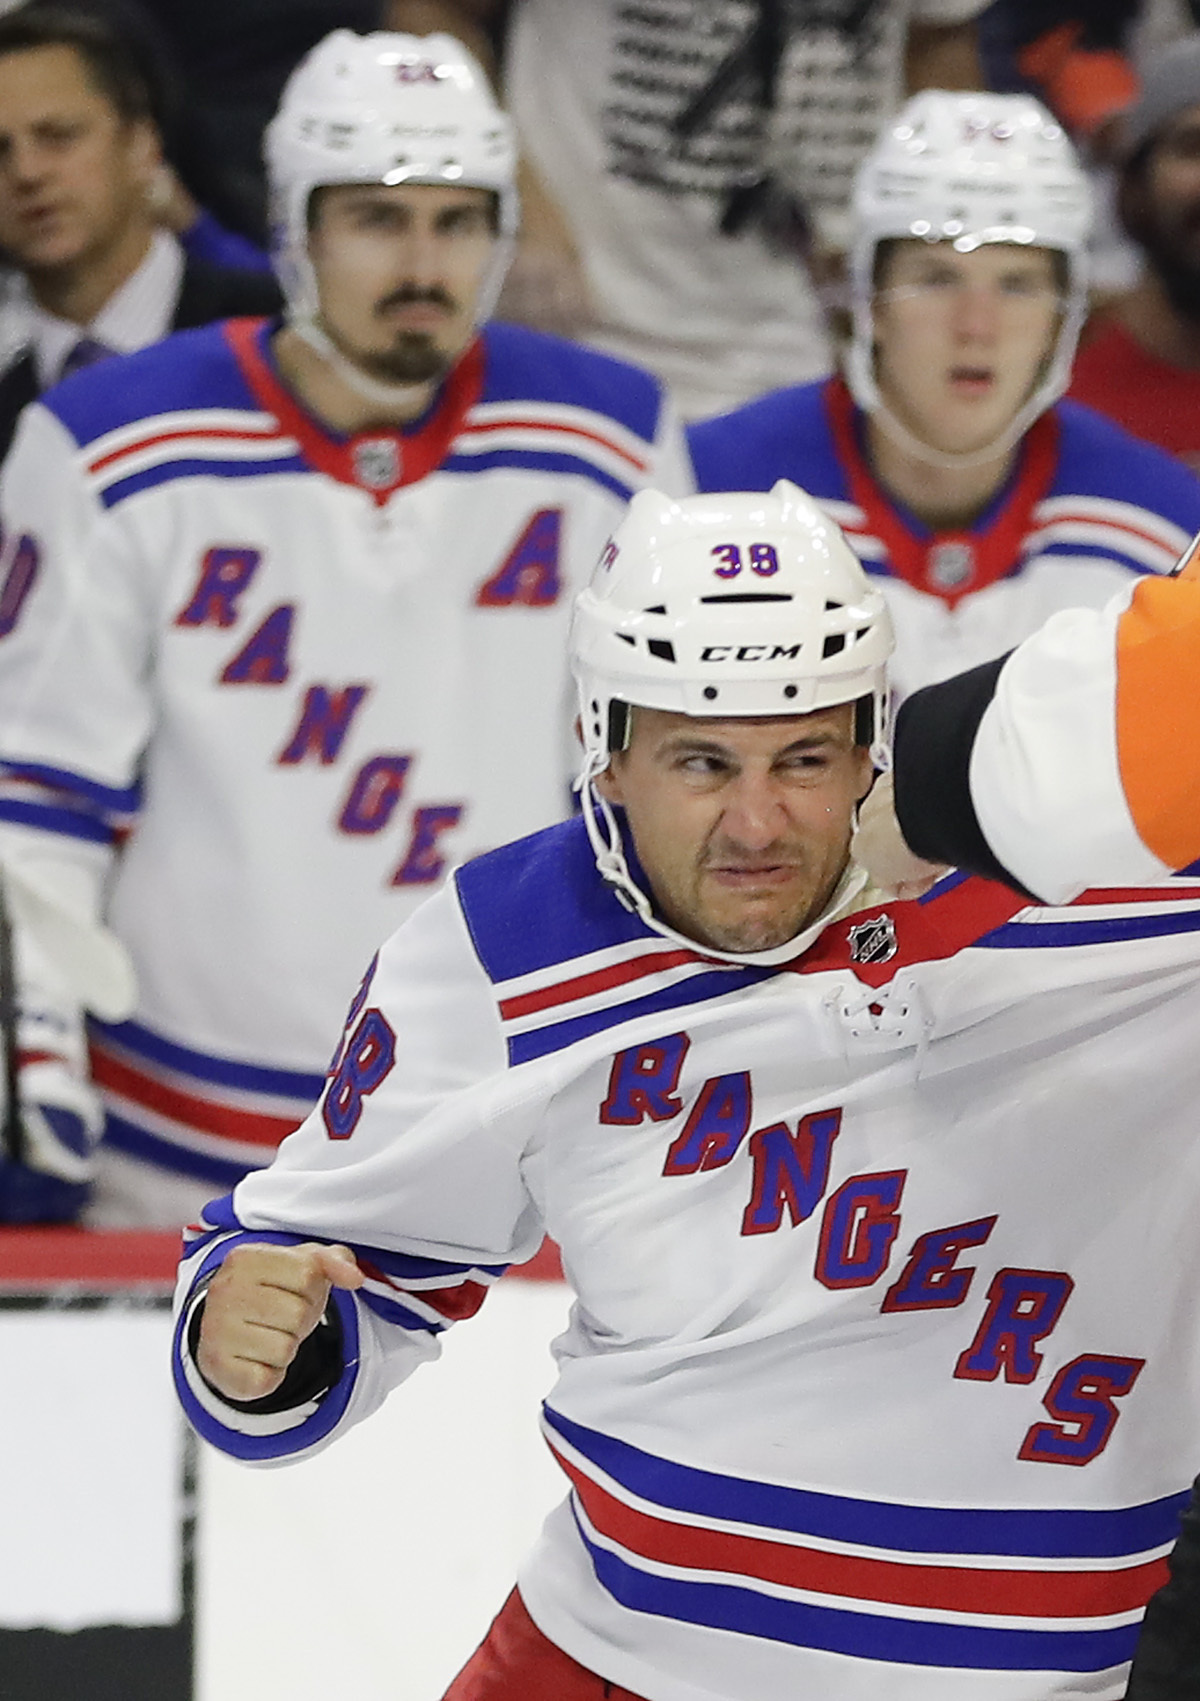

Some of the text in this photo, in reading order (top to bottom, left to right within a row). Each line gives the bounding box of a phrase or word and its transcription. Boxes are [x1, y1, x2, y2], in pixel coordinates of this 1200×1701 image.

[476, 507, 563, 607] A
[711, 543, 779, 579] 38
[700, 644, 802, 662] CCM
[173, 547, 468, 888] RANGE
[599, 1031, 1146, 1466] RANGERS
